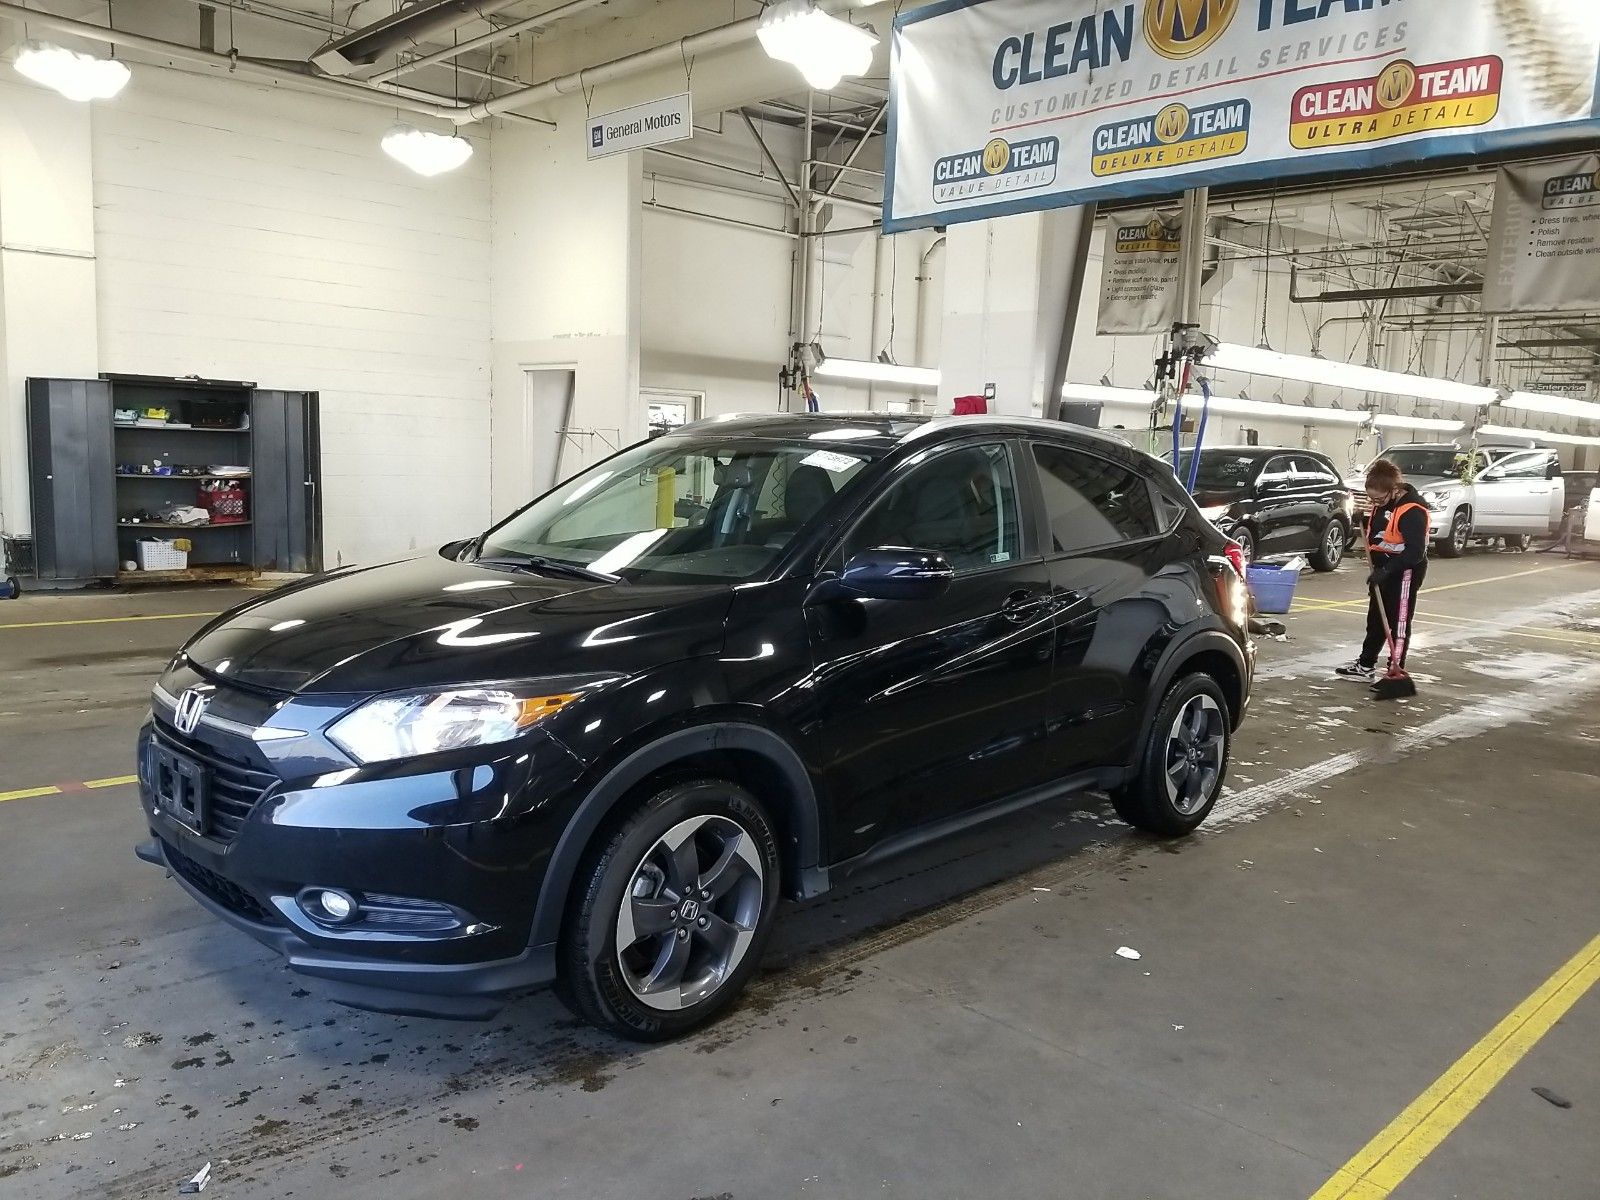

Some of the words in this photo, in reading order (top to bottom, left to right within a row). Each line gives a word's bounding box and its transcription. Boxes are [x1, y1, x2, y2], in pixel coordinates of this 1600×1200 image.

[992, 4, 1134, 91] CLEAN
[991, 79, 1133, 125] CUSTOMIZED
[1148, 56, 1238, 91] DETAIL
[1257, 21, 1408, 69] SERVICES
[1300, 85, 1374, 117] CLEAN
[1418, 63, 1491, 98] TEAM
[606, 119, 642, 140] General
[644, 112, 681, 132] Motors
[1096, 120, 1152, 151] CLEAN
[1191, 104, 1245, 135] TEAM
[1307, 118, 1378, 140] ULTRA
[1392, 103, 1475, 128] DETAIL
[936, 154, 981, 181] CLEAN
[1012, 140, 1055, 168] TEAM
[1100, 150, 1165, 170] DELUXE
[1177, 137, 1236, 158] DETAIL
[940, 181, 985, 198] VALUE
[995, 170, 1046, 188] DETAIL
[1546, 176, 1592, 194] CLEAN
[1119, 228, 1146, 240] CLEAN
[1537, 227, 1560, 236] Polish
[1539, 216, 1560, 225] Dress
[1535, 249, 1556, 258] Clean
[1536, 238, 1566, 247] Remove
[1537, 383, 1587, 392] Enterprise
